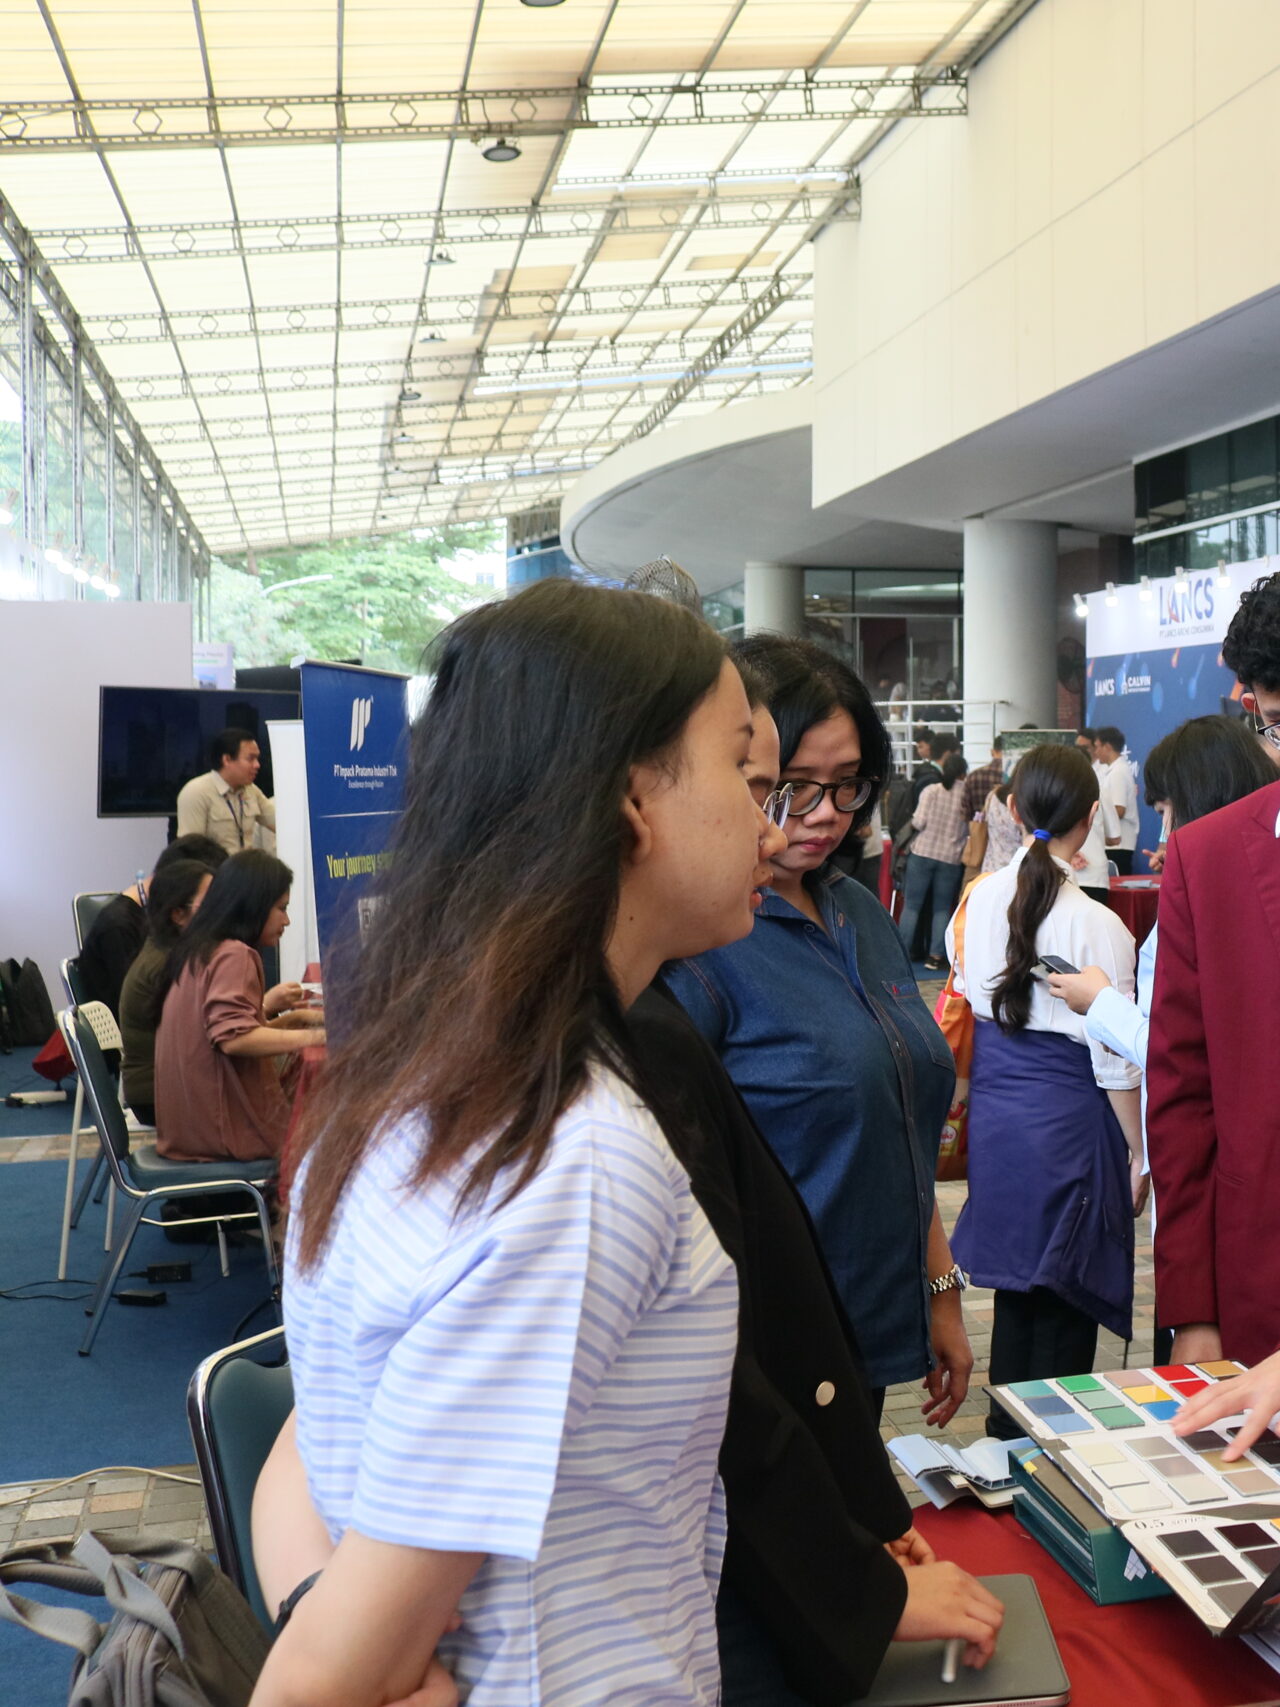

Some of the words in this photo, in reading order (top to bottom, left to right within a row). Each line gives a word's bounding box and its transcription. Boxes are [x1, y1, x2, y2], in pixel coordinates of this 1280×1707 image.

[1160, 577, 1214, 626] LANCS
[1094, 678, 1115, 697] LANCS
[1127, 675, 1152, 688] CALVIN
[326, 854, 346, 879] Your
[346, 852, 376, 880] journey
[1134, 1518, 1164, 1530] 0.5
